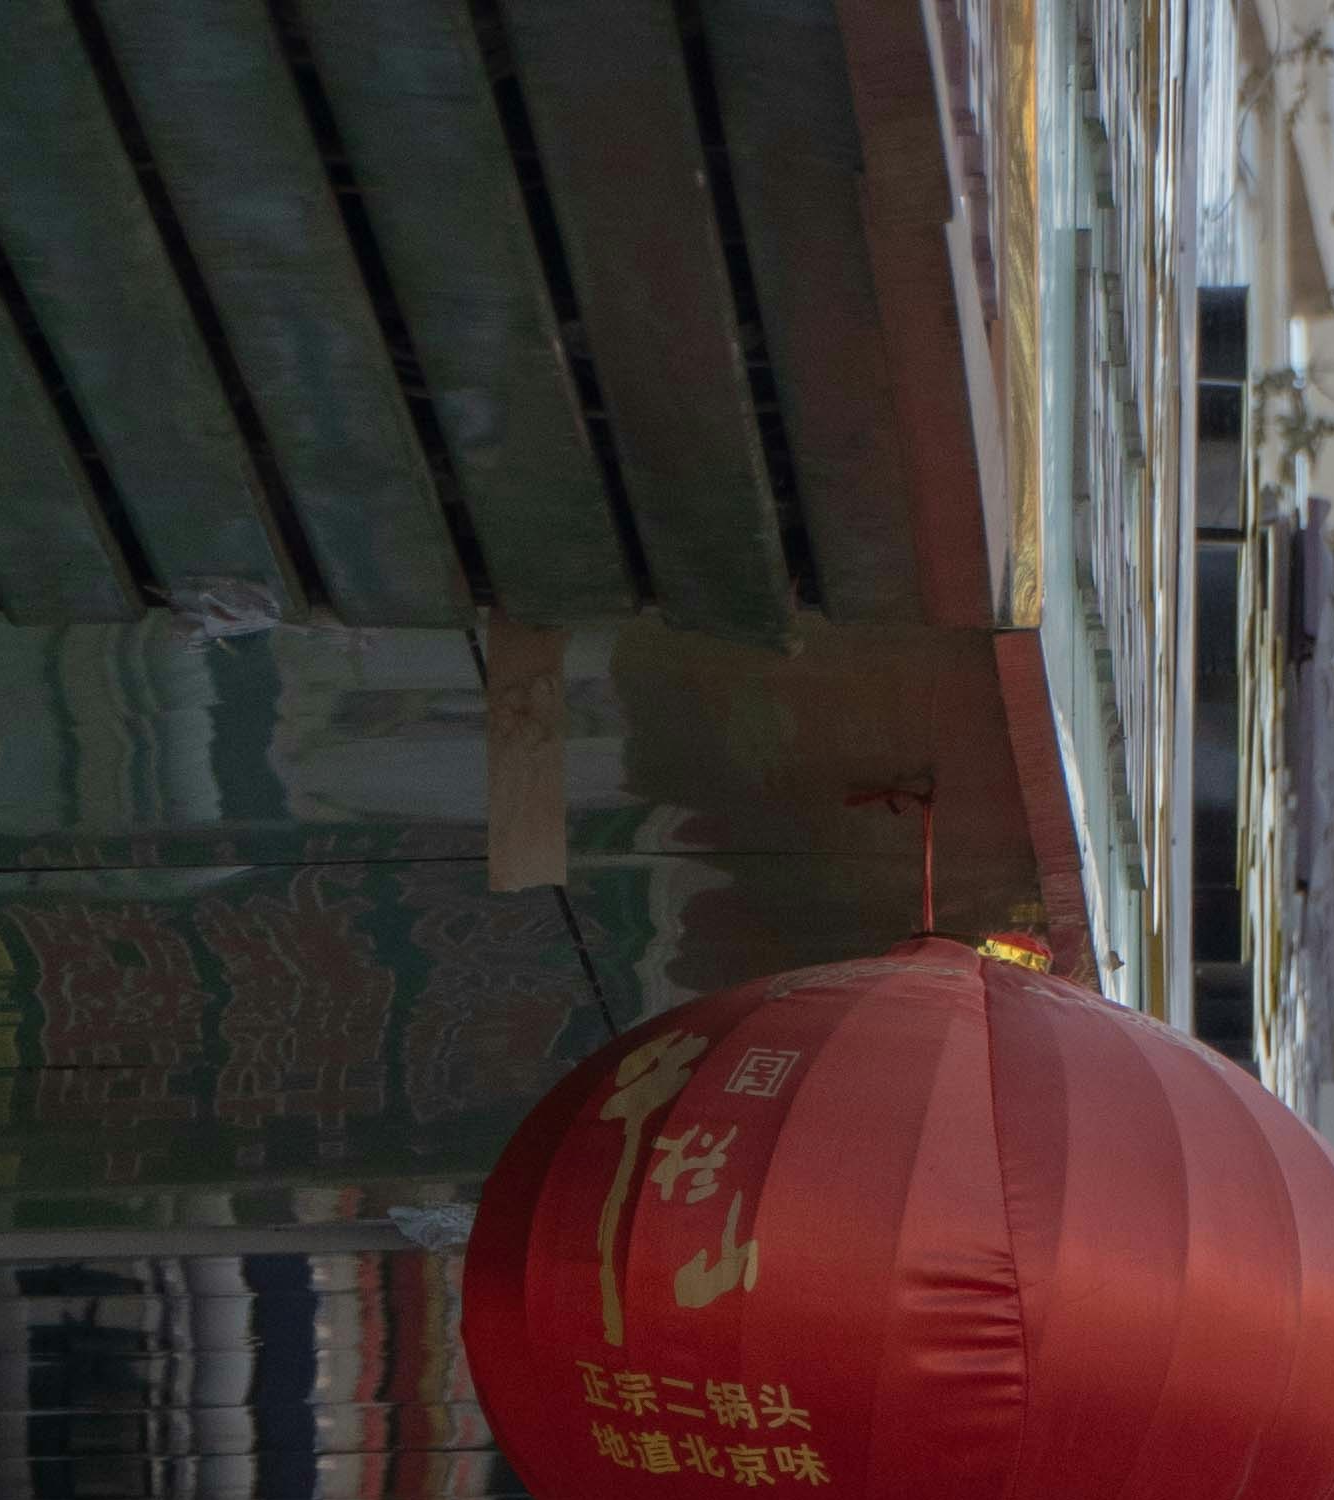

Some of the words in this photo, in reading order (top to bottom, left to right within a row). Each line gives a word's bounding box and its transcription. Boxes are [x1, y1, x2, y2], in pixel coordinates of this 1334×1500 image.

[597, 1028, 759, 1347] 牛栏山
[574, 1360, 813, 1432] 正宗二锅头
[590, 1421, 832, 1487] 地道北京味
